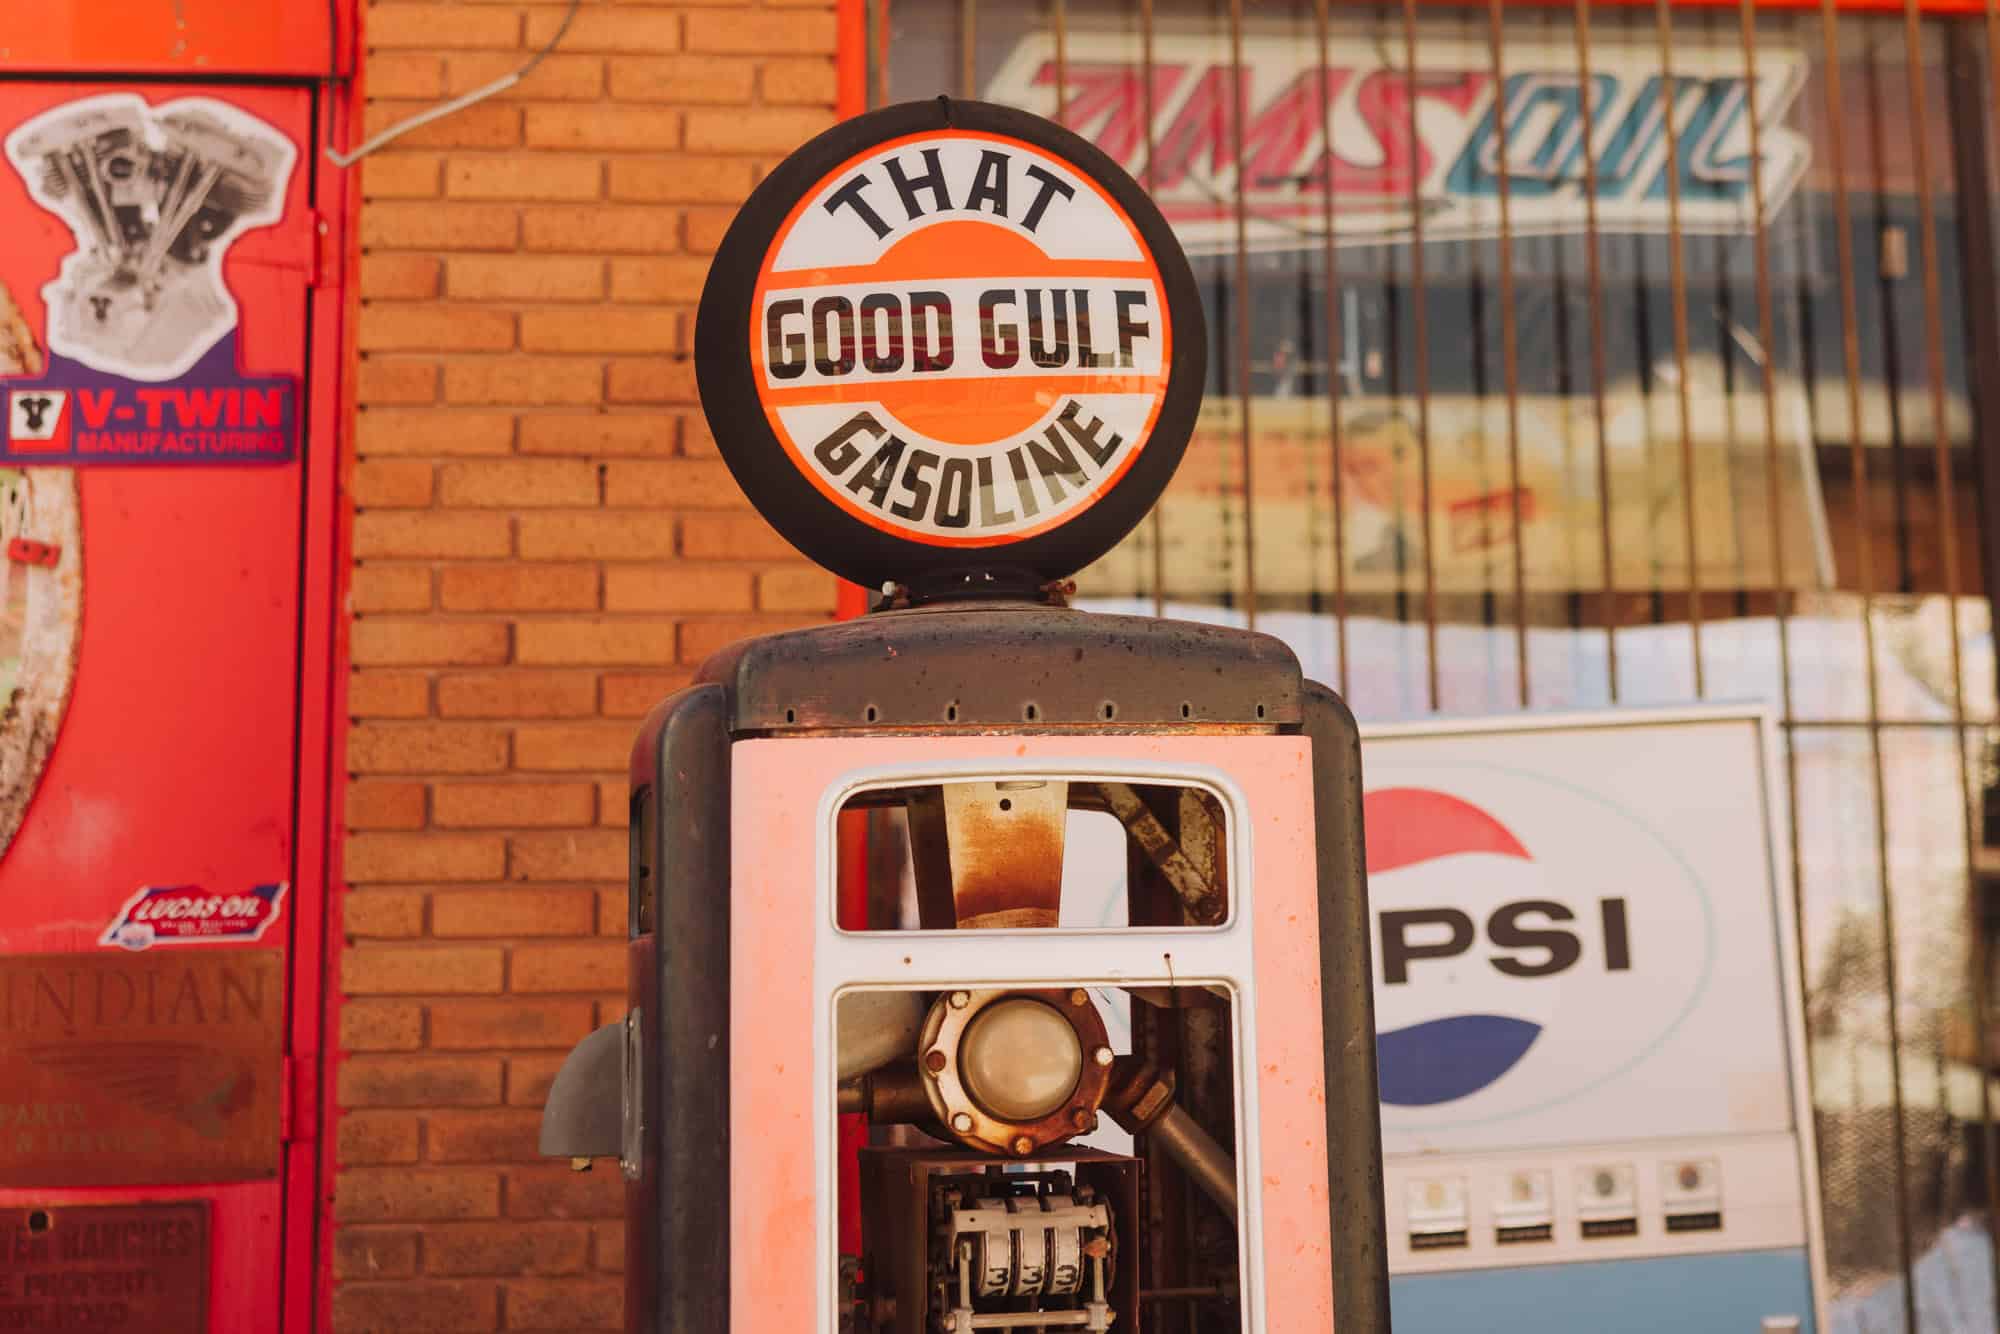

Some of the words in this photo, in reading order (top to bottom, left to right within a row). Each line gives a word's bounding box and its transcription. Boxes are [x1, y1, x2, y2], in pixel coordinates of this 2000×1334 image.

[1030, 60, 1757, 201] AMSOIL
[823, 147, 1076, 241] THAT
[766, 291, 955, 380] GOOD
[978, 288, 1150, 370] GULF
[77, 388, 282, 428] V-TWIN
[77, 431, 285, 454] MANUFACTURING
[813, 399, 1123, 529] GASOLINE
[1379, 898, 1631, 985] PSI
[6, 967, 267, 1027] INDIAN
